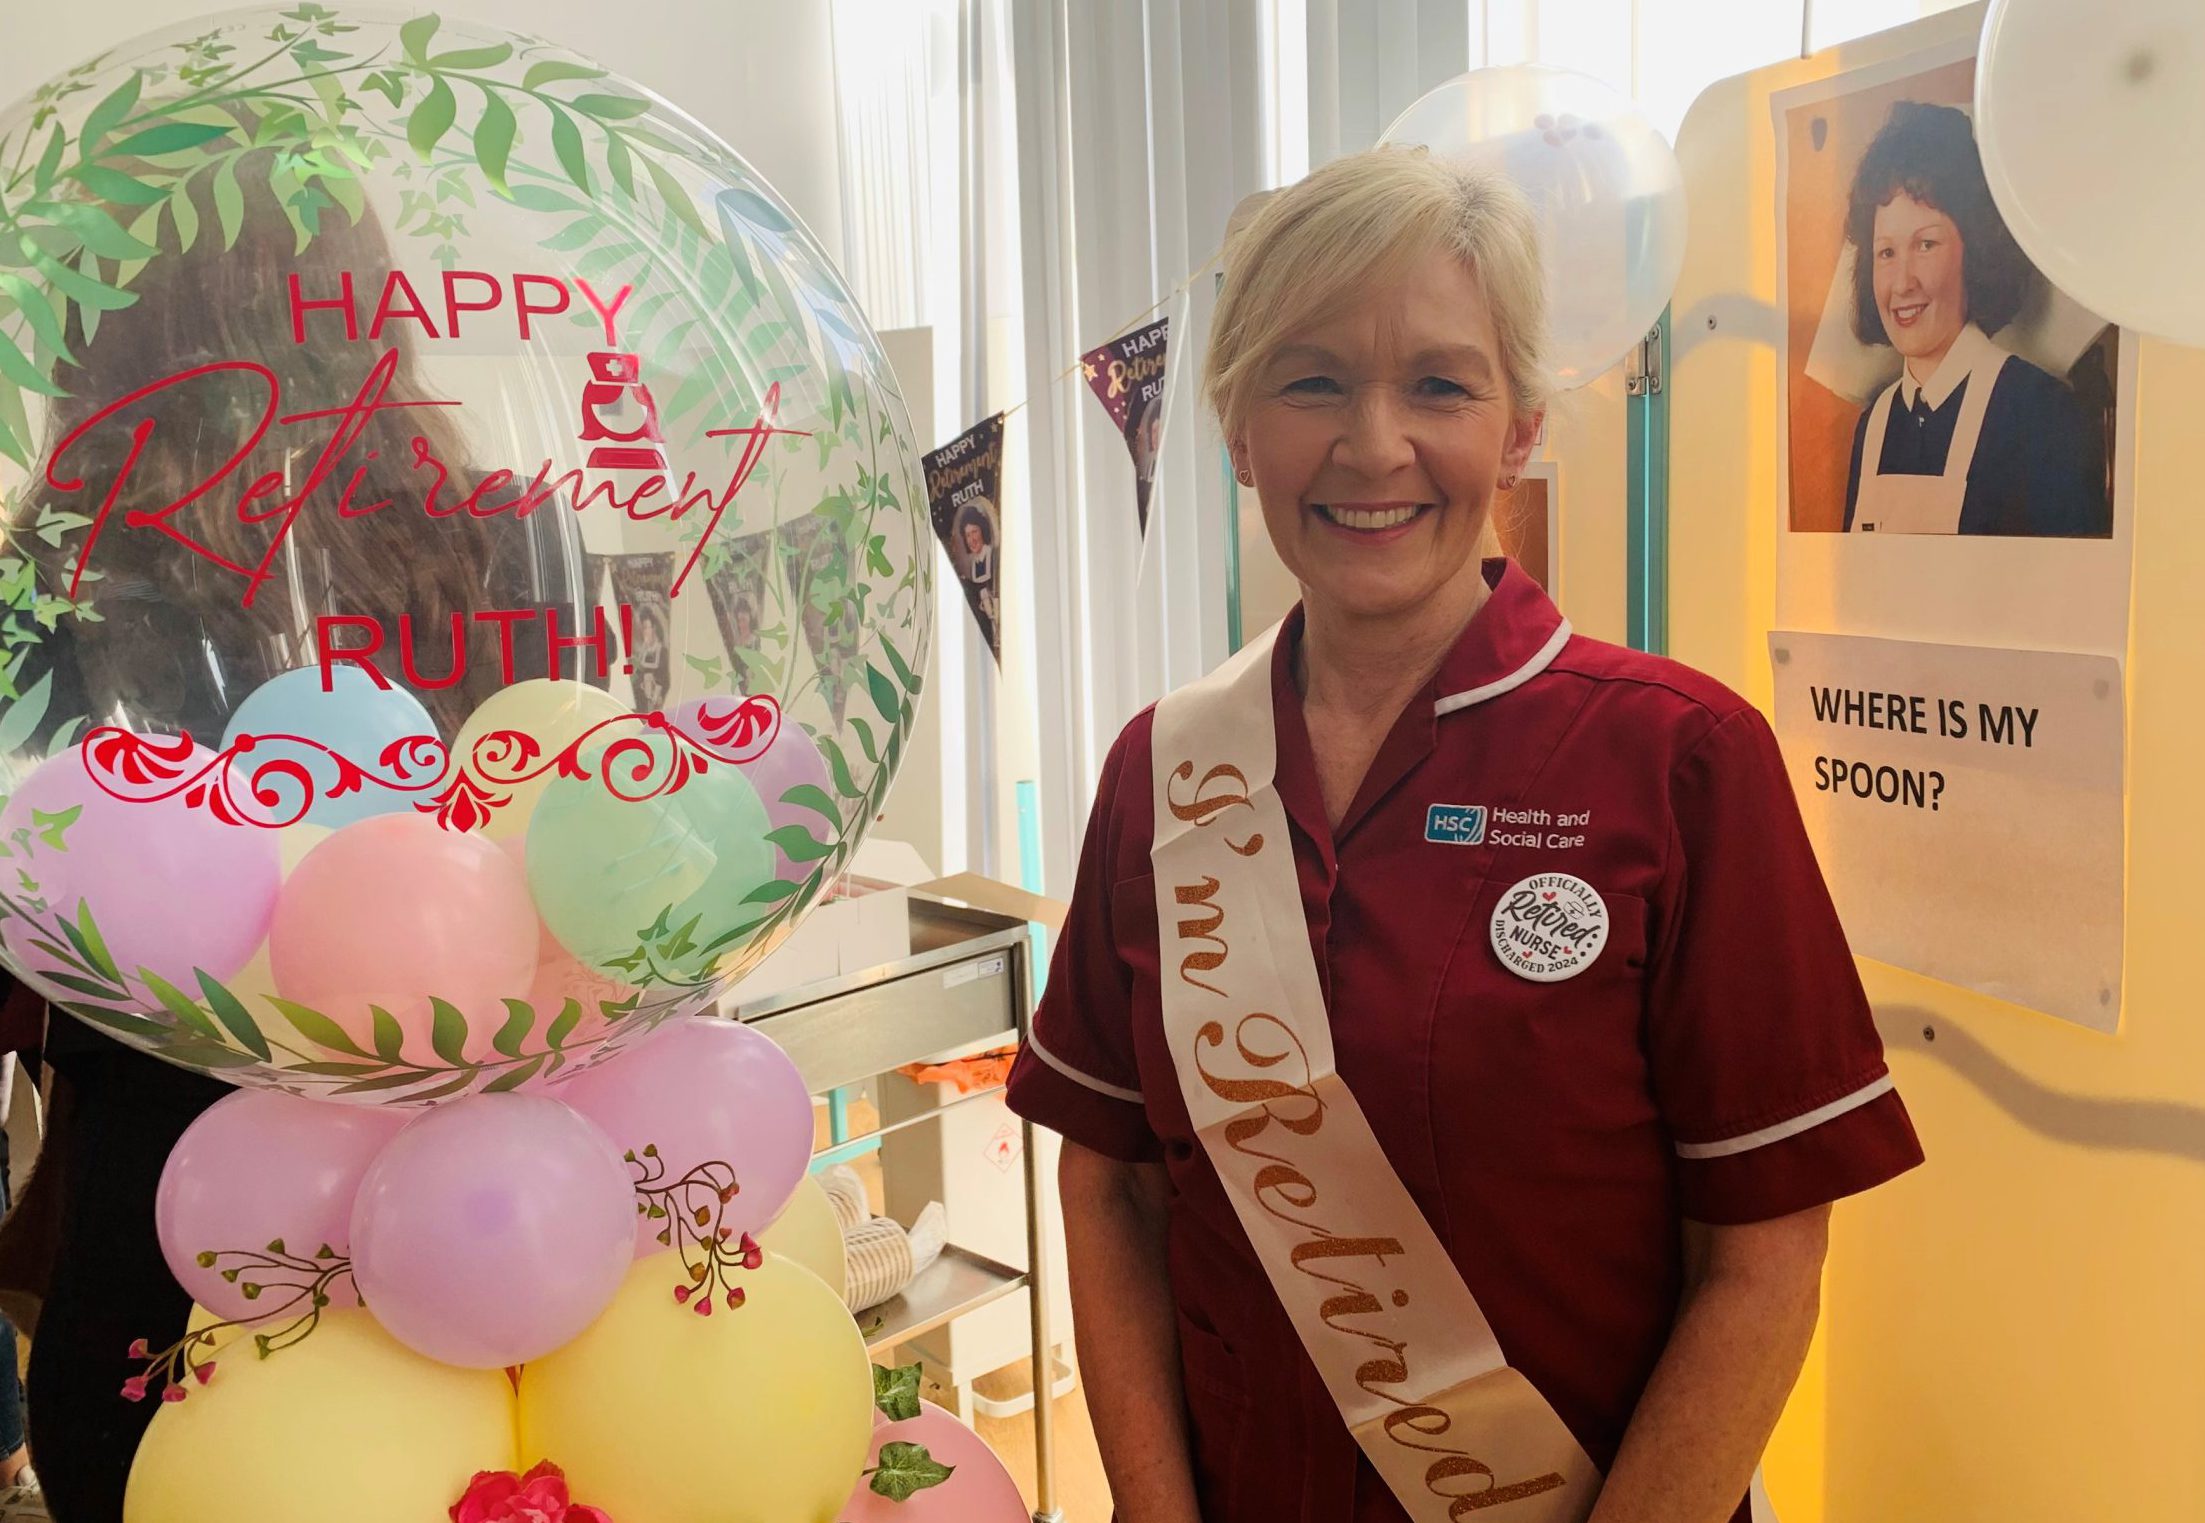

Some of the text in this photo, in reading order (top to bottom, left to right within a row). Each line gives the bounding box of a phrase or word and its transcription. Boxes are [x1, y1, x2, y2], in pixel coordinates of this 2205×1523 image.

[288, 270, 633, 347] HAPPY
[1121, 324, 1168, 358] HAPP
[1107, 352, 1167, 399] Retire
[1141, 376, 1165, 402] RU
[935, 433, 976, 468] HAPPY
[45, 348, 813, 608] Retirement
[951, 478, 985, 508] RUTH
[316, 603, 634, 692] RUTH!
[1810, 686, 2039, 748] WHERE IS MY
[1814, 756, 1945, 811] SPOON?
[1434, 814, 1473, 832] HSC
[1492, 806, 1591, 827] Health and
[1489, 829, 1585, 849] Social Care
[1529, 877, 1602, 918] OFFICIALLY
[1495, 919, 1580, 973] DISCHARGED 2024
[1509, 925, 1562, 960] NURSE
[1167, 760, 1568, 1523] I'm Retired
